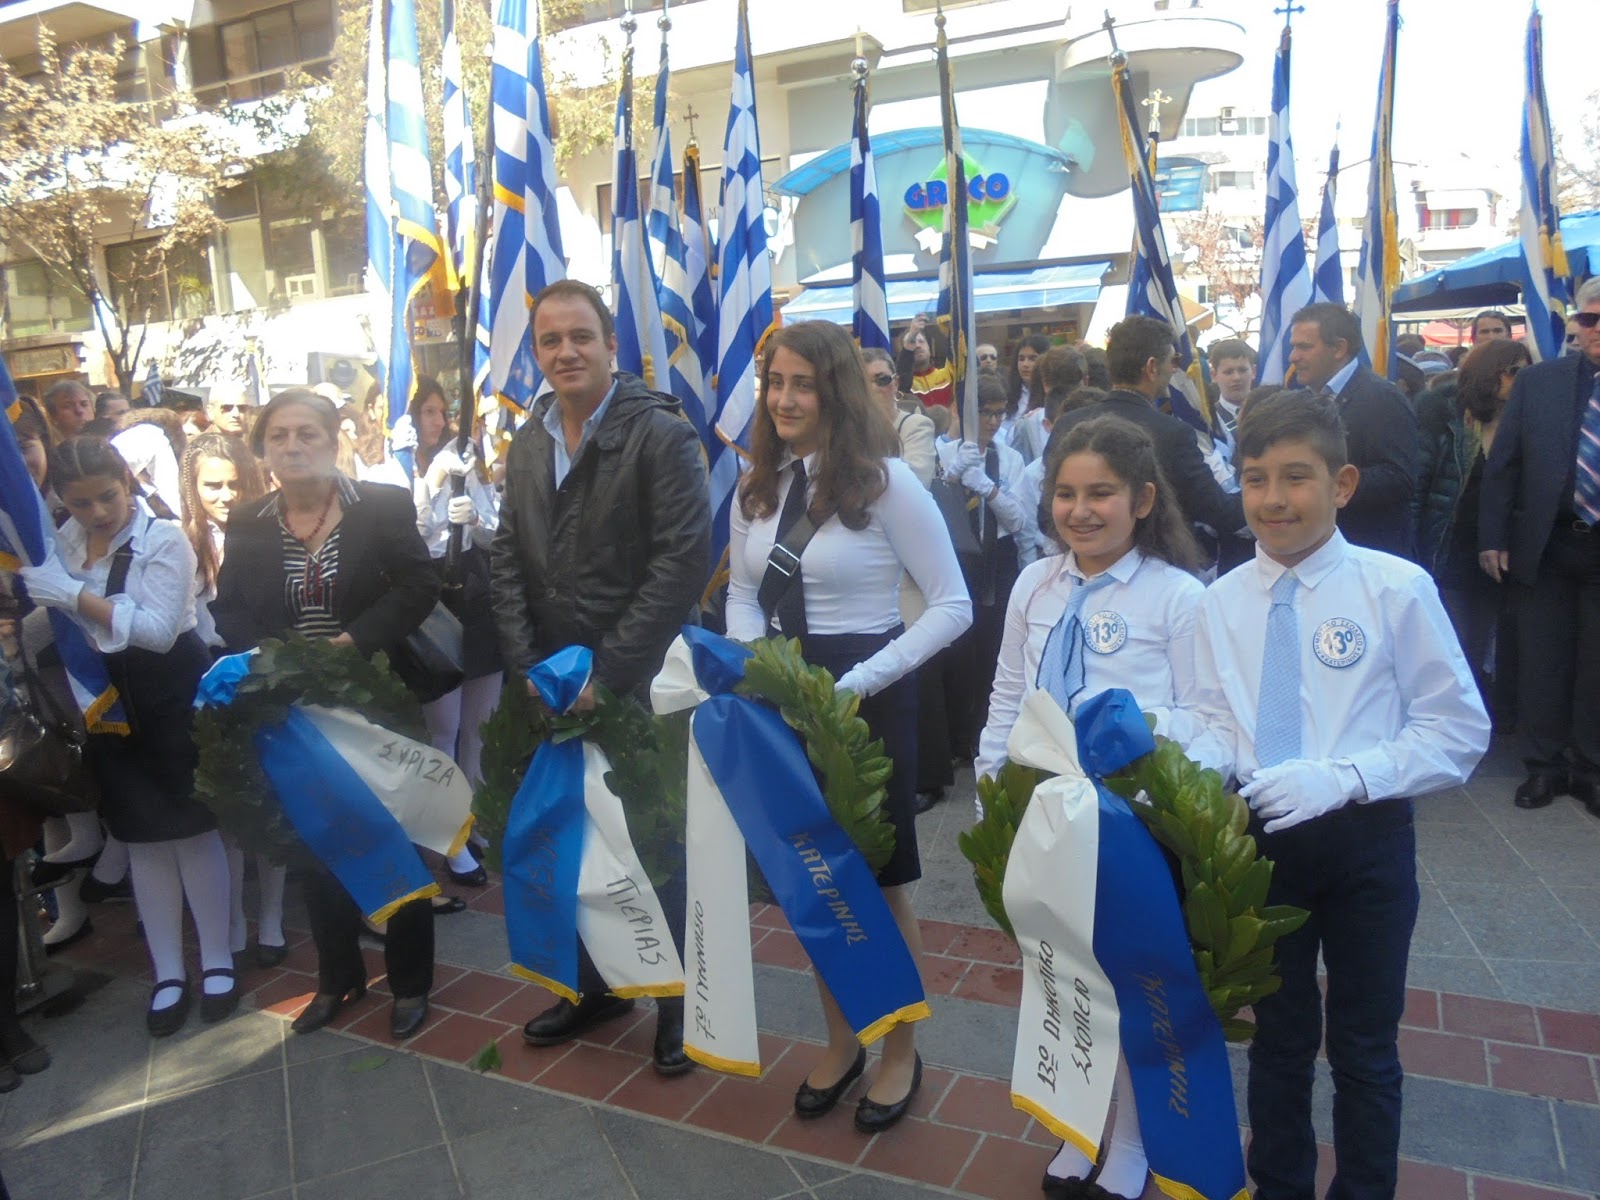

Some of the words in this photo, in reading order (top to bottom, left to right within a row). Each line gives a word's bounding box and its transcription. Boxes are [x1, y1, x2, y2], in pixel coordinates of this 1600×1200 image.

[904, 173, 1009, 209] GRCO
[377, 741, 455, 788] ΣΥΡΙΖΑ
[606, 874, 668, 966] ΠΙΕΡΙΑΣ
